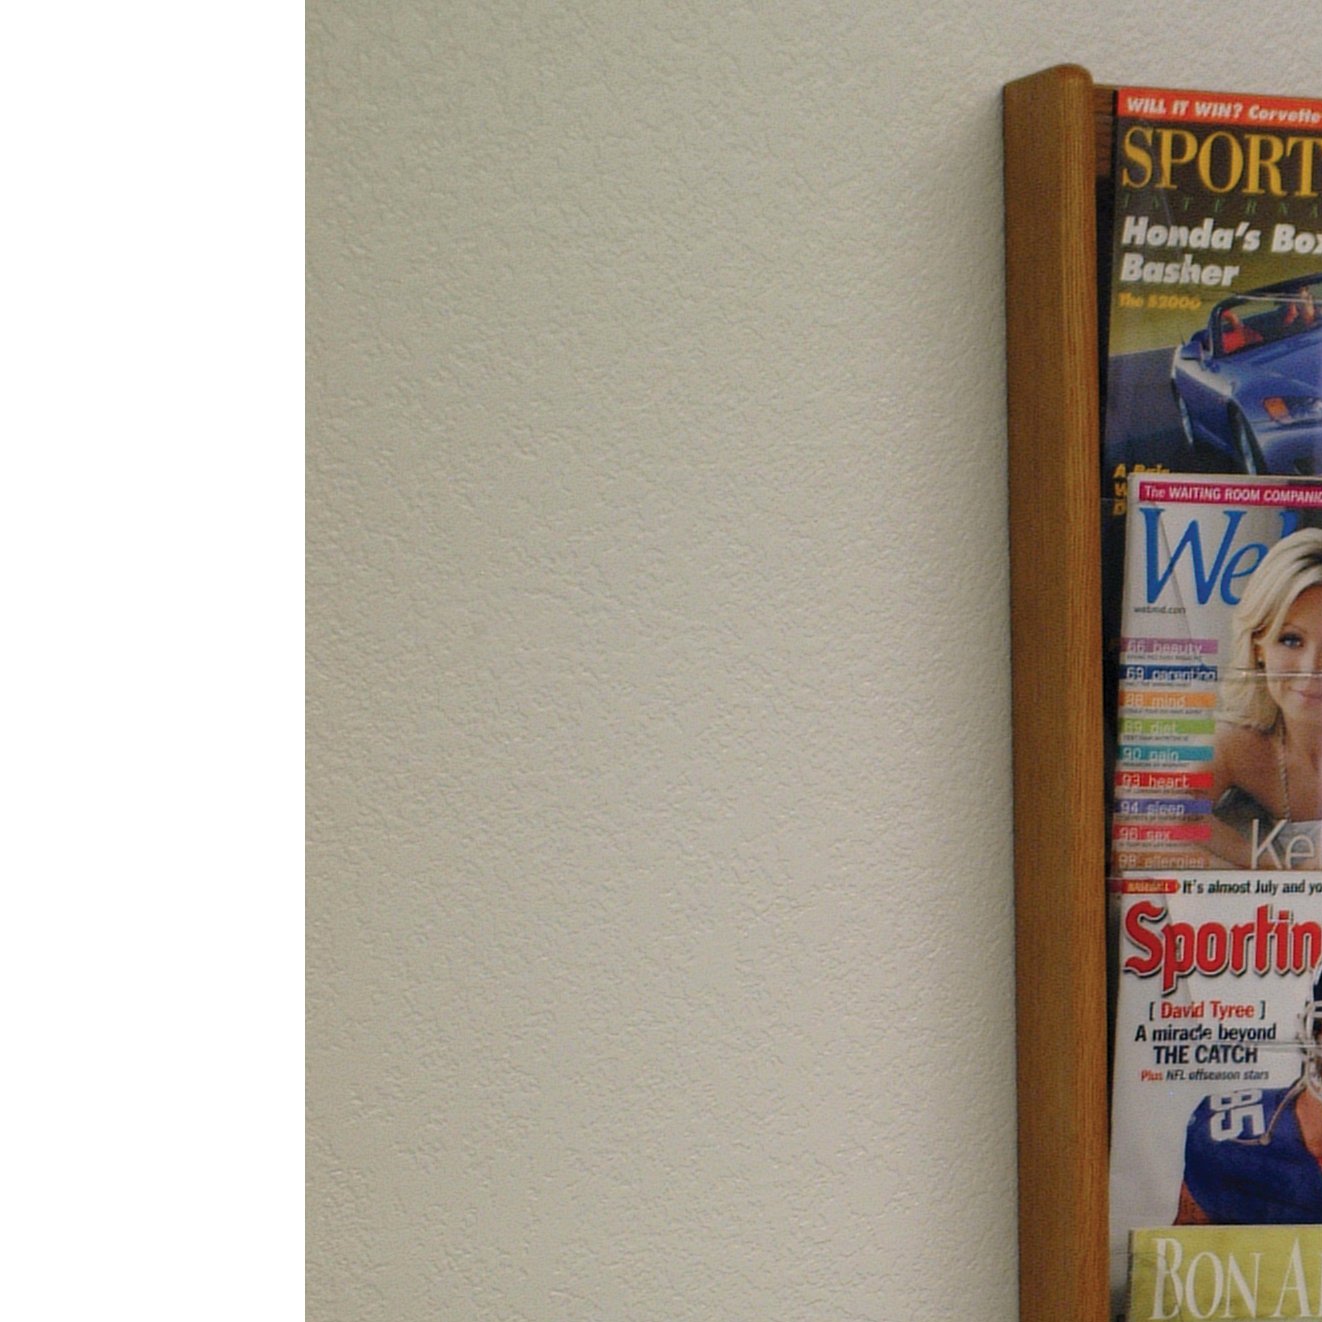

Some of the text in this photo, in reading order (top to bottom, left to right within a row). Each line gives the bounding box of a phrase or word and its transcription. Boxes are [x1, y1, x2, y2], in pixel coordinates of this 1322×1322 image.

[1126, 97, 1167, 114] WILL
[1173, 99, 1189, 116] IT
[1195, 101, 1244, 119] WIN?
[1121, 214, 1261, 251] Honda's
[1120, 252, 1240, 287] Basher
[1144, 484, 1166, 498] The
[1169, 486, 1221, 500] WAITING
[1225, 487, 1260, 501] ROOM
[1183, 879, 1204, 894] It's
[1207, 879, 1250, 894] almost
[1254, 880, 1279, 896] July
[1282, 879, 1306, 894] and
[1161, 1000, 1205, 1019] David
[1209, 1000, 1255, 1022] Tyree
[1135, 1023, 1277, 1043] A miracle beyond
[1153, 1044, 1258, 1065] THE CATCH
[1141, 1068, 1269, 1081] Plus NFL offseason stars
[1149, 1237, 1260, 1320] BON
